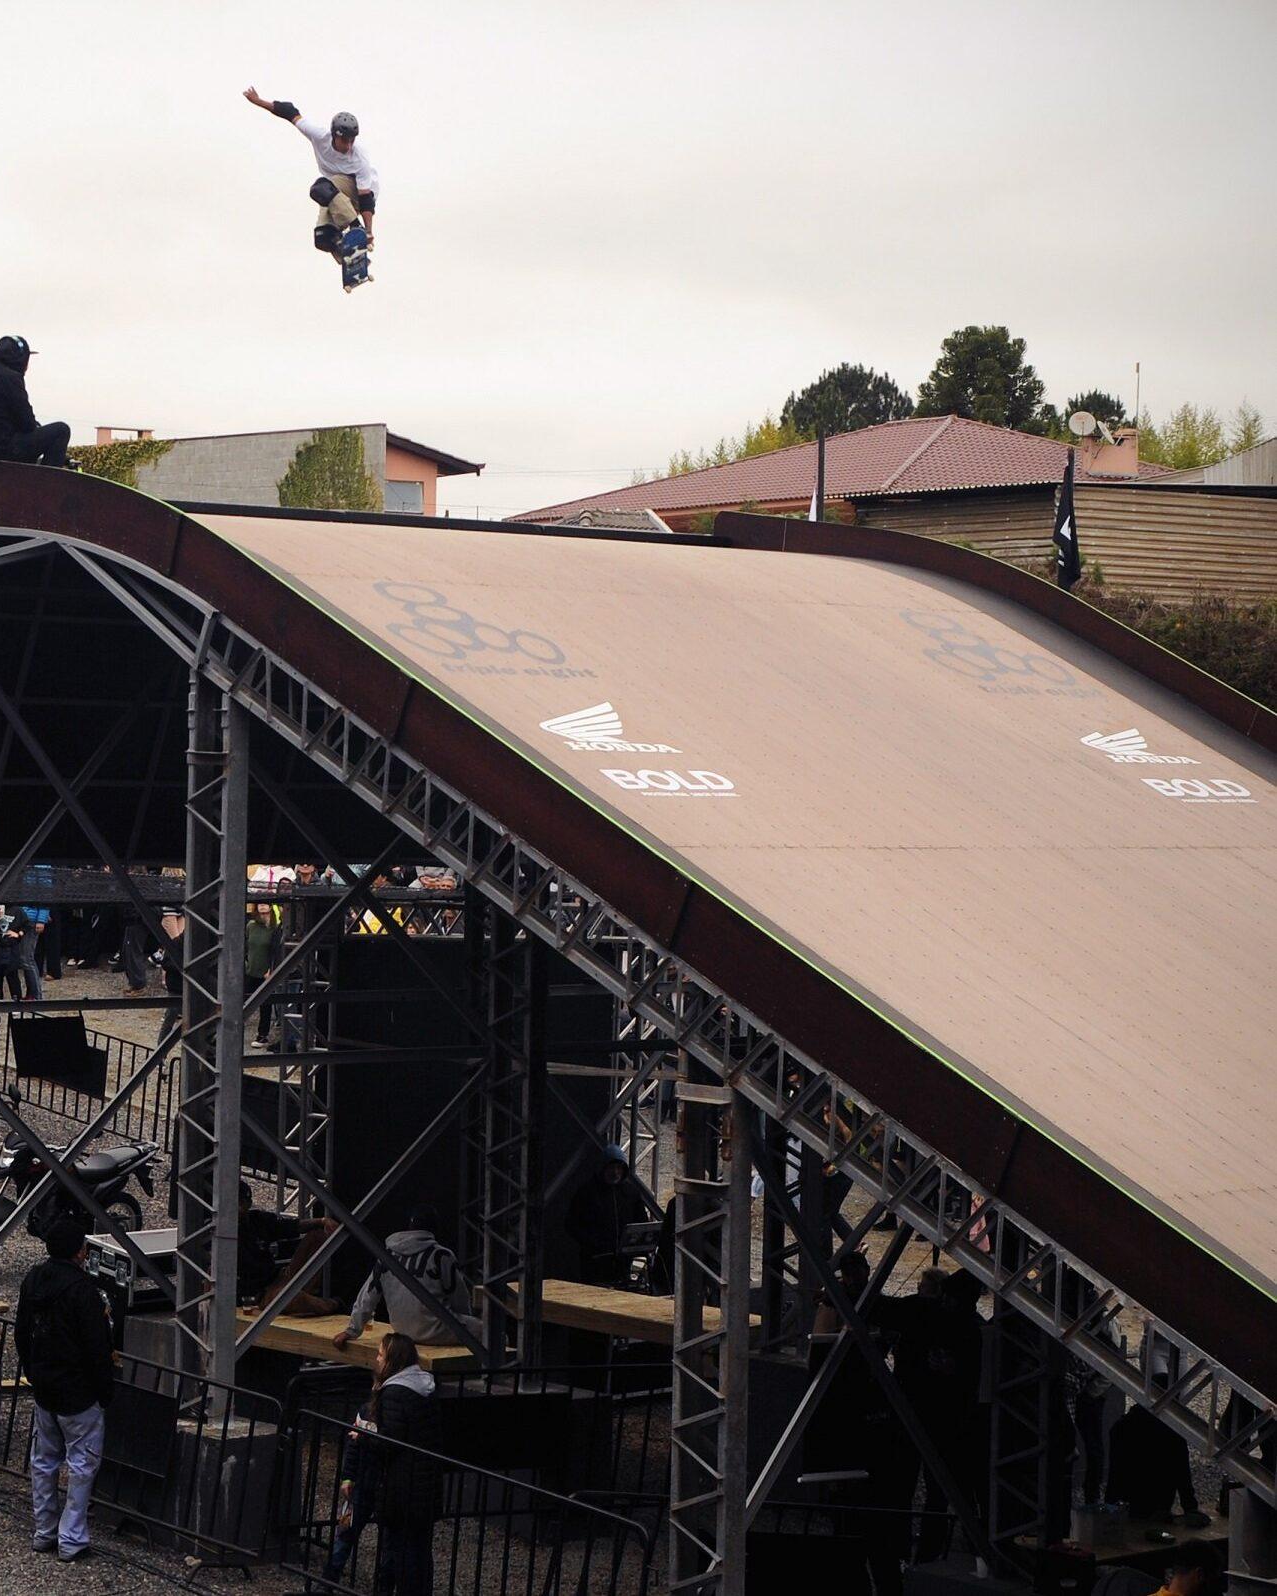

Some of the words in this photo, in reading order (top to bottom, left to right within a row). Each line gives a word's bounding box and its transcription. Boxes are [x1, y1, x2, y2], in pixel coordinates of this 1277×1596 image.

[523, 668, 598, 678] eight
[563, 741, 684, 753] HONDA
[1105, 754, 1202, 764] HONDA
[599, 769, 734, 791] BOLD
[1140, 778, 1251, 797] BOLD
